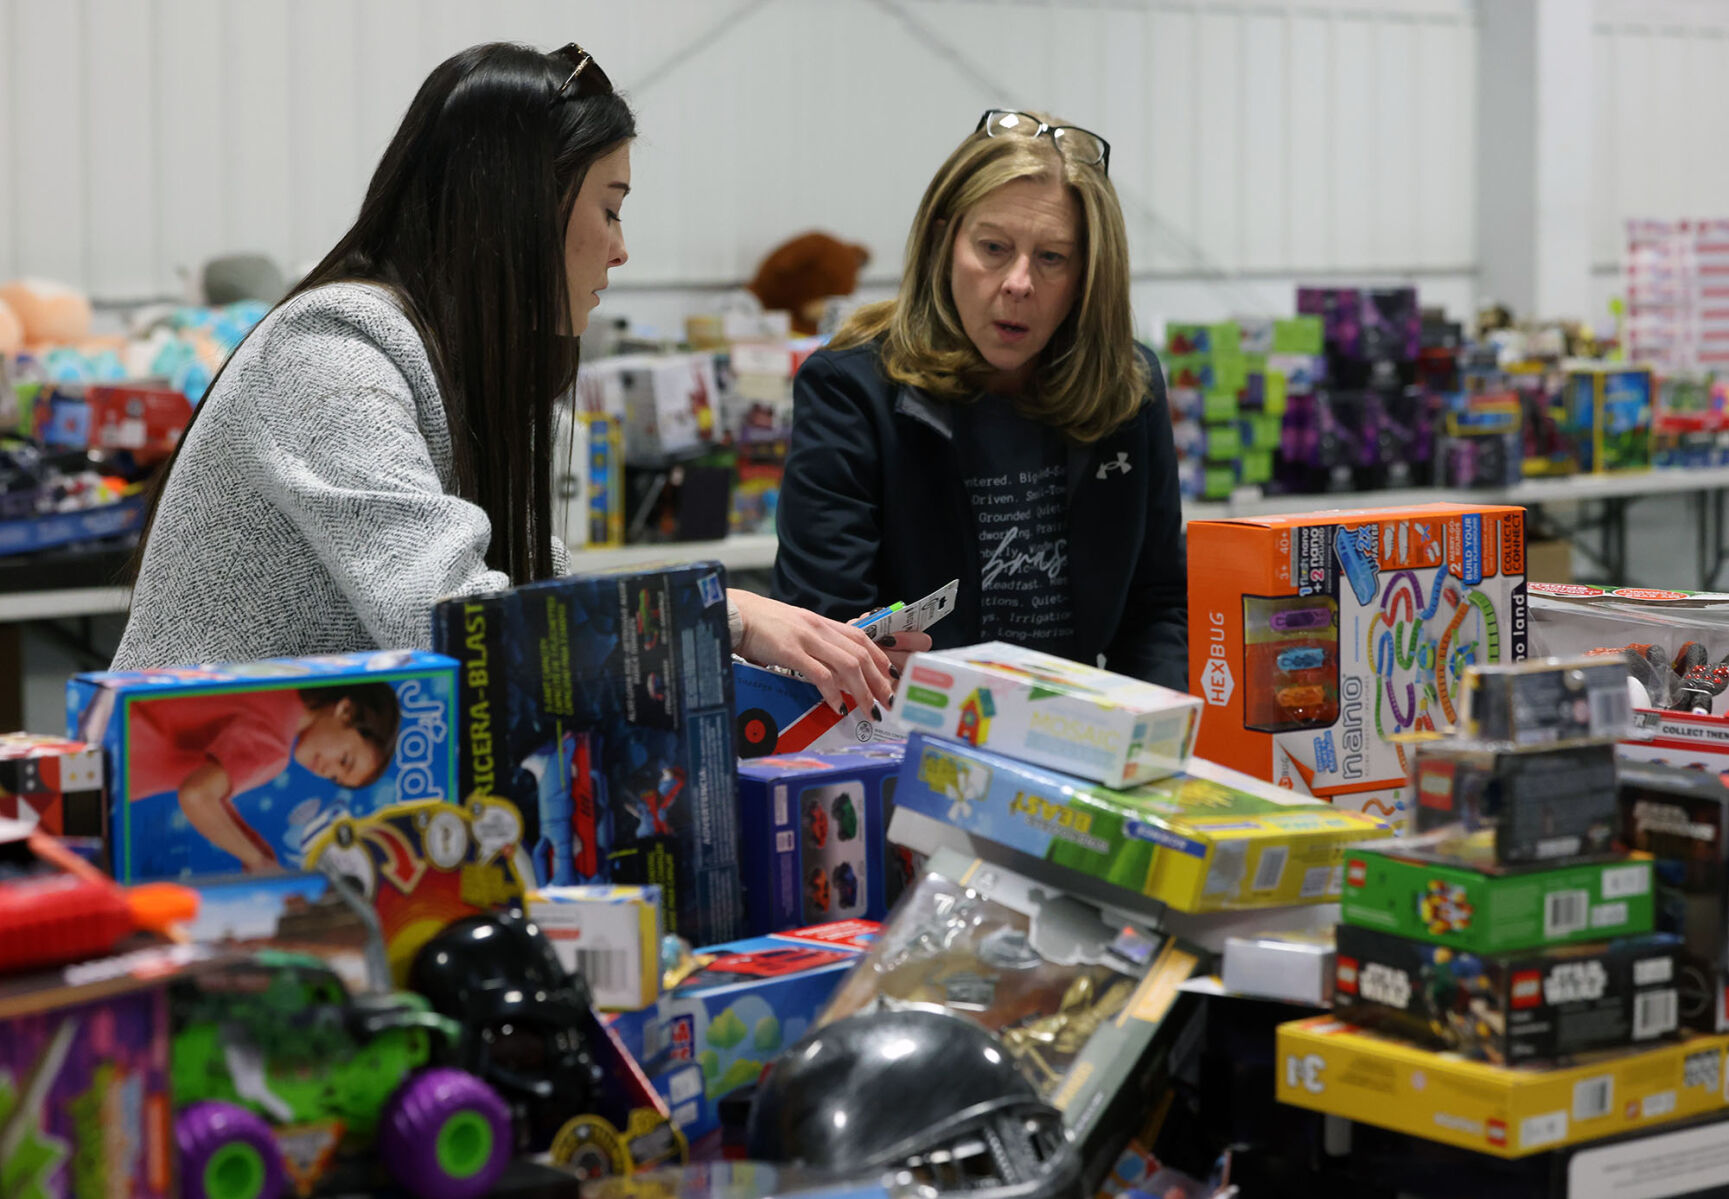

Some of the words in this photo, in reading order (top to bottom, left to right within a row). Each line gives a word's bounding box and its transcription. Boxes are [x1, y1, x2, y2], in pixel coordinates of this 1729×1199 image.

[1301, 529, 1309, 557] nano
[1310, 528, 1319, 568] nano
[1464, 517, 1472, 547] YOUR
[1464, 549, 1473, 581] BUILD
[1513, 594, 1525, 636] land
[1209, 611, 1225, 704] HEXBUG
[1342, 675, 1363, 779] nano
[1661, 724, 1704, 738] COLLECT
